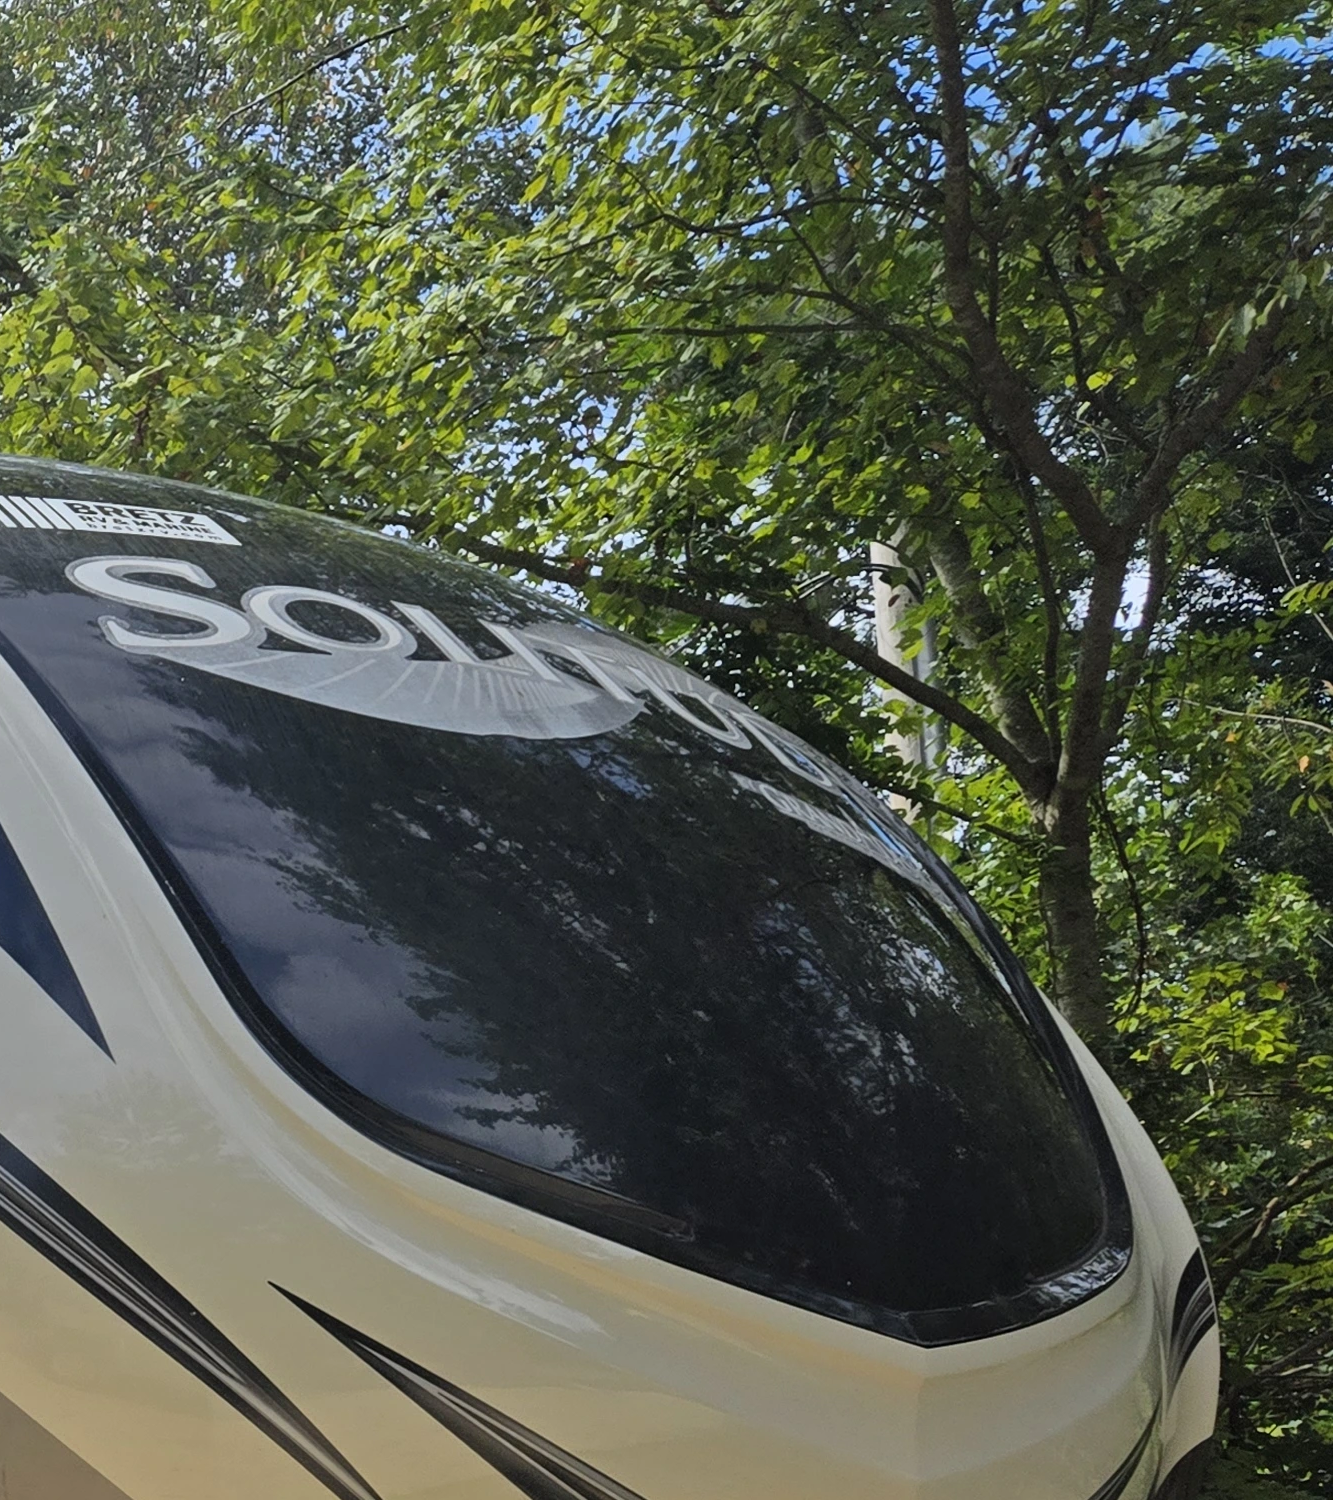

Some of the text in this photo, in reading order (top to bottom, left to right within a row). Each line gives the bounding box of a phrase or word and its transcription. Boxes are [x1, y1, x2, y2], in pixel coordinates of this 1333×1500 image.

[63, 501, 206, 527] BRETZ
[77, 515, 108, 524] RV
[134, 519, 216, 535] MARINE
